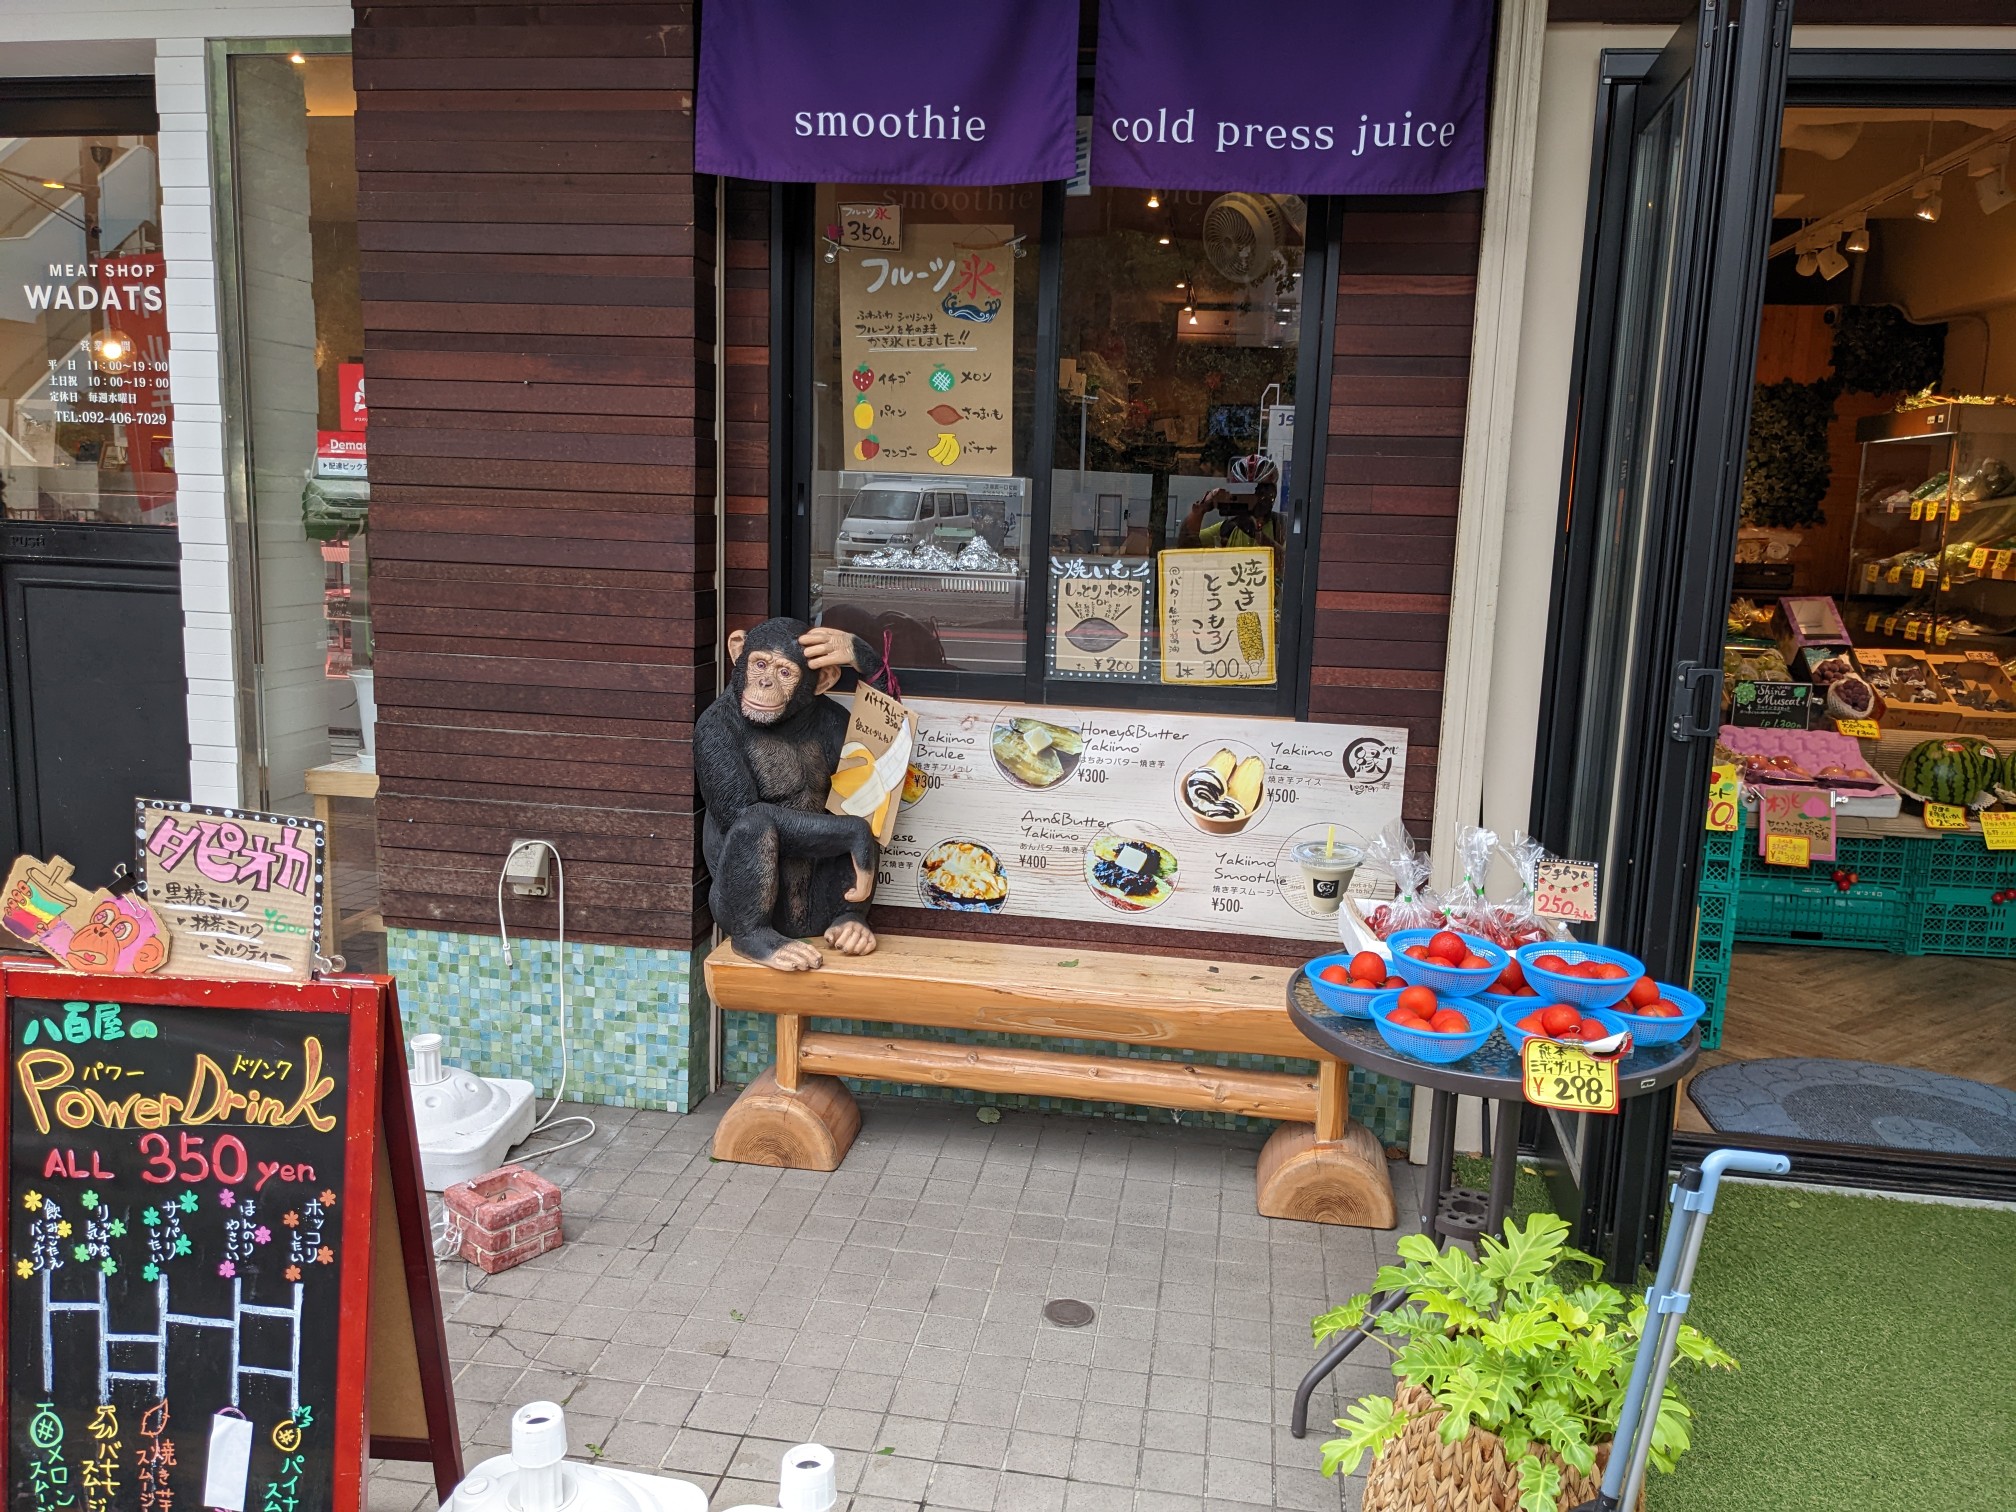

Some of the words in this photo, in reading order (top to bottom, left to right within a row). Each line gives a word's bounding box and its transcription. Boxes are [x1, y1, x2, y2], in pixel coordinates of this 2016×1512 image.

[794, 104, 987, 142] smoothie
[1112, 108, 1195, 144] cold
[1215, 121, 1335, 152] press
[1350, 110, 1456, 158] juice
[842, 207, 891, 220] フルーツ氷
[50, 264, 98, 277] MEAT
[105, 264, 155, 277] SHOP
[861, 253, 1002, 300] フルーツ氷
[24, 285, 163, 312] WADATS
[855, 323, 938, 336] フルーツをそのまま
[49, 375, 78, 387] 土日祝
[878, 371, 911, 384] イチゴ
[960, 371, 992, 384] メロン
[49, 391, 78, 403] 定休日
[88, 391, 137, 404] 毎週水曜日
[54, 410, 167, 425] TEL:092-406-7029
[880, 404, 907, 418] パイン
[962, 406, 1003, 421] さつまいも
[882, 446, 917, 458] マンゴー
[963, 440, 998, 454] バナナ
[1063, 557, 1130, 579] 焼いも
[1065, 583, 1101, 600] しっとり
[1757, 684, 1787, 696] Shine
[1756, 694, 1800, 706] Muscat
[918, 729, 975, 745] Yakiimo
[1081, 721, 1189, 742] Honey&Butter
[916, 744, 965, 760] Brulee
[1081, 738, 1140, 754] Yakiimo
[1271, 741, 1333, 759] Yakiimo
[1080, 756, 1166, 769] はちみつバター焼き芋
[1269, 760, 1291, 771] Ice
[1267, 775, 1322, 787] 焼き芋アイス
[1766, 792, 1801, 819] 桃
[1021, 810, 1114, 829] Ann&Butter
[893, 834, 917, 843] ese
[1021, 826, 1080, 841] Yakiimo
[147, 815, 313, 896] タピオカ
[1019, 843, 1087, 855] あんバター焼き芋
[1215, 852, 1276, 868] Yakiimo
[1213, 868, 1288, 886] Smoothie
[165, 883, 250, 912] 黒糖ミルク
[1212, 884, 1282, 897] 焼き芋スムージー
[190, 913, 264, 939] 抹茶ミルク
[213, 938, 293, 962] ミルクティー
[23, 1002, 158, 1045] 八百屋の
[83, 1062, 145, 1082] パワー
[232, 1054, 293, 1081] ドリンク
[44, 1149, 115, 1179] ALL
[139, 1131, 249, 1185] 350
[255, 1160, 317, 1191] yen
[98, 1204, 112, 1257] リッチな
[162, 1200, 181, 1260] サッパリ
[240, 1199, 256, 1256] ほんのり
[304, 1198, 324, 1263] ホッコリ
[31, 1219, 46, 1271] バッチリ
[87, 1220, 99, 1256] 気分
[148, 1228, 165, 1263] したい
[226, 1219, 240, 1261] やさしい
[291, 1230, 304, 1262] したい
[48, 1445, 75, 1506] メロン
[99, 1441, 122, 1496] バナナ
